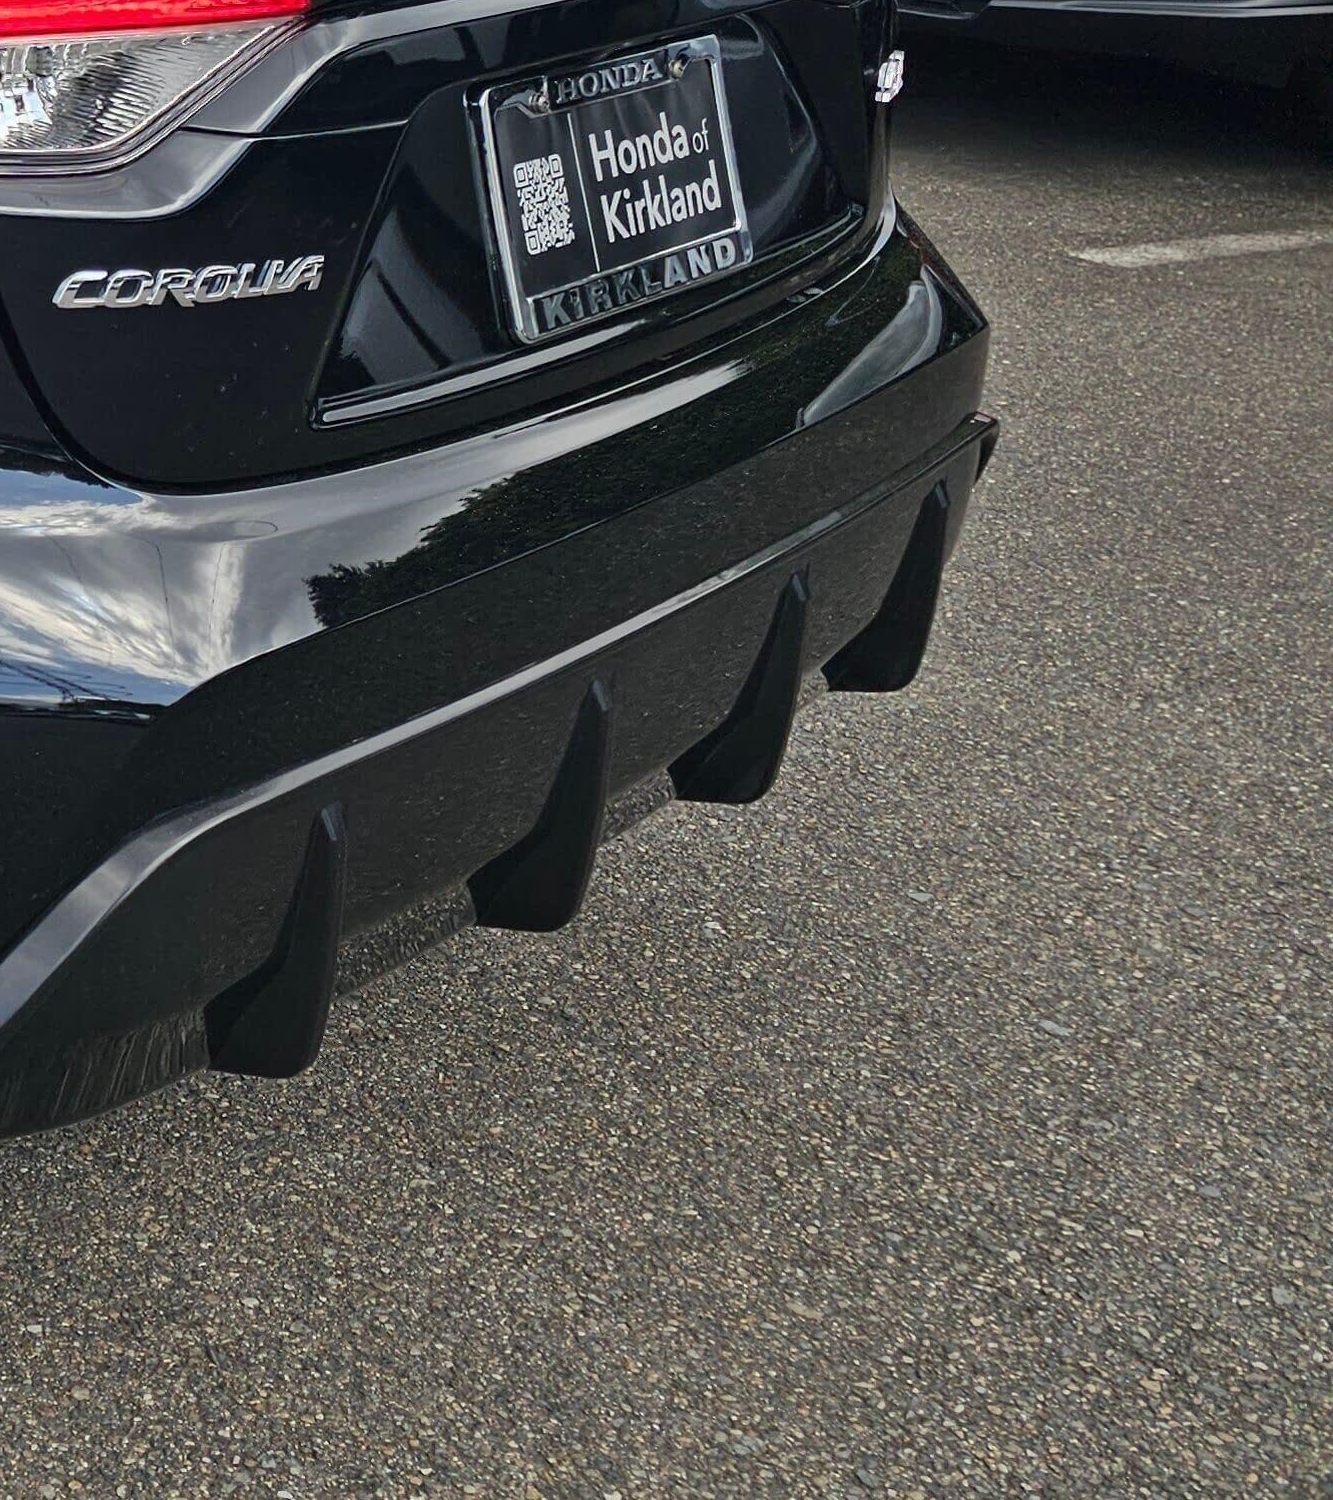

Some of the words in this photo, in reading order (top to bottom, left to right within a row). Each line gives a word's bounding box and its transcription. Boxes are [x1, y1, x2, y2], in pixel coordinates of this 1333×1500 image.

[555, 58, 663, 103] HONDA
[589, 111, 690, 182] Honda
[692, 117, 710, 154] of
[600, 159, 722, 243] Kirkland
[52, 255, 325, 308] COROLLA
[541, 238, 735, 329] KIRKLAND
